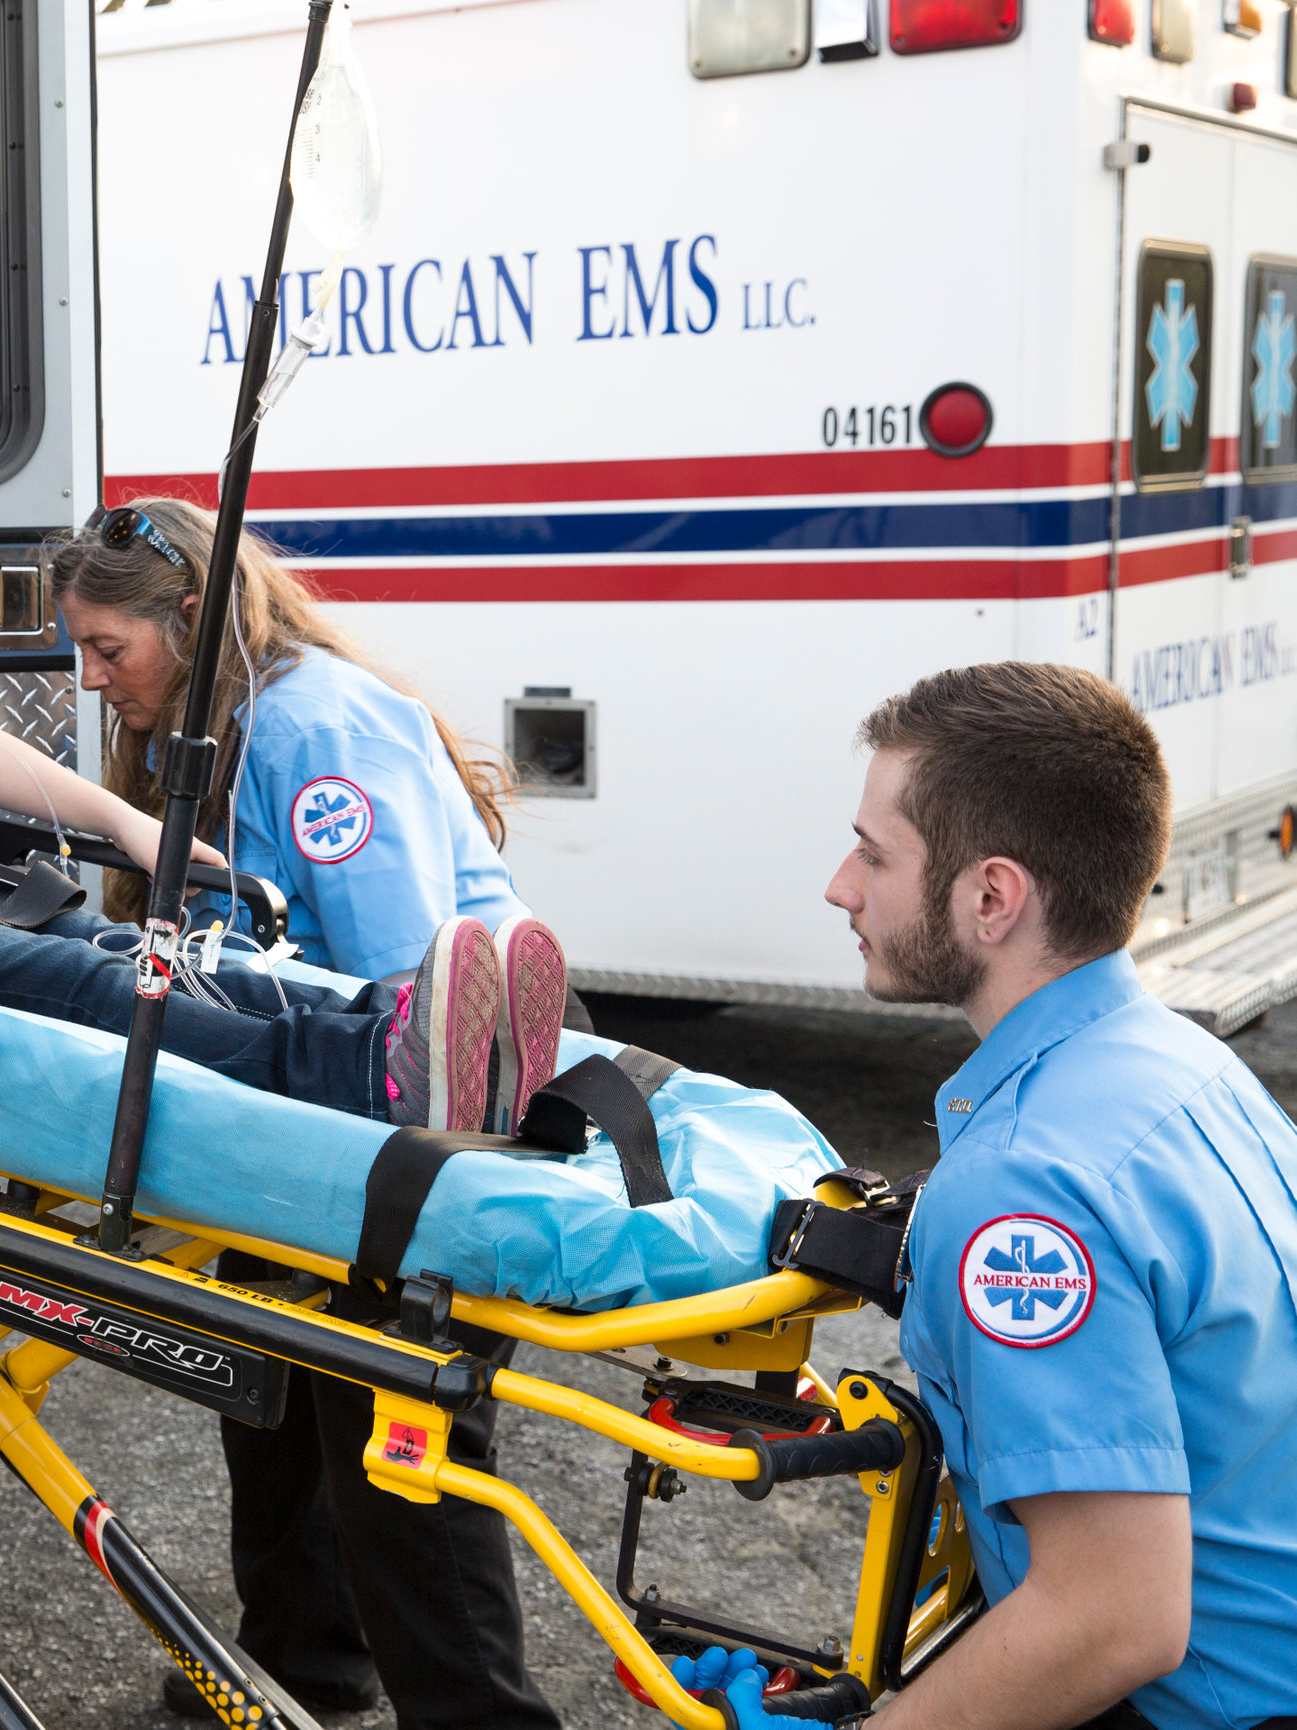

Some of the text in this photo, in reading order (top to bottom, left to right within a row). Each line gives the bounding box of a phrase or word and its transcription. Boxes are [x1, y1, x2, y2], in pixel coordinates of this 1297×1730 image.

[576, 233, 719, 342] EMS
[823, 405, 911, 447] 04161
[1132, 632, 1235, 713] AMERICAN
[217, 1283, 273, 1304] 650 LB
[973, 1274, 1087, 1289] AMERICAN EMS
